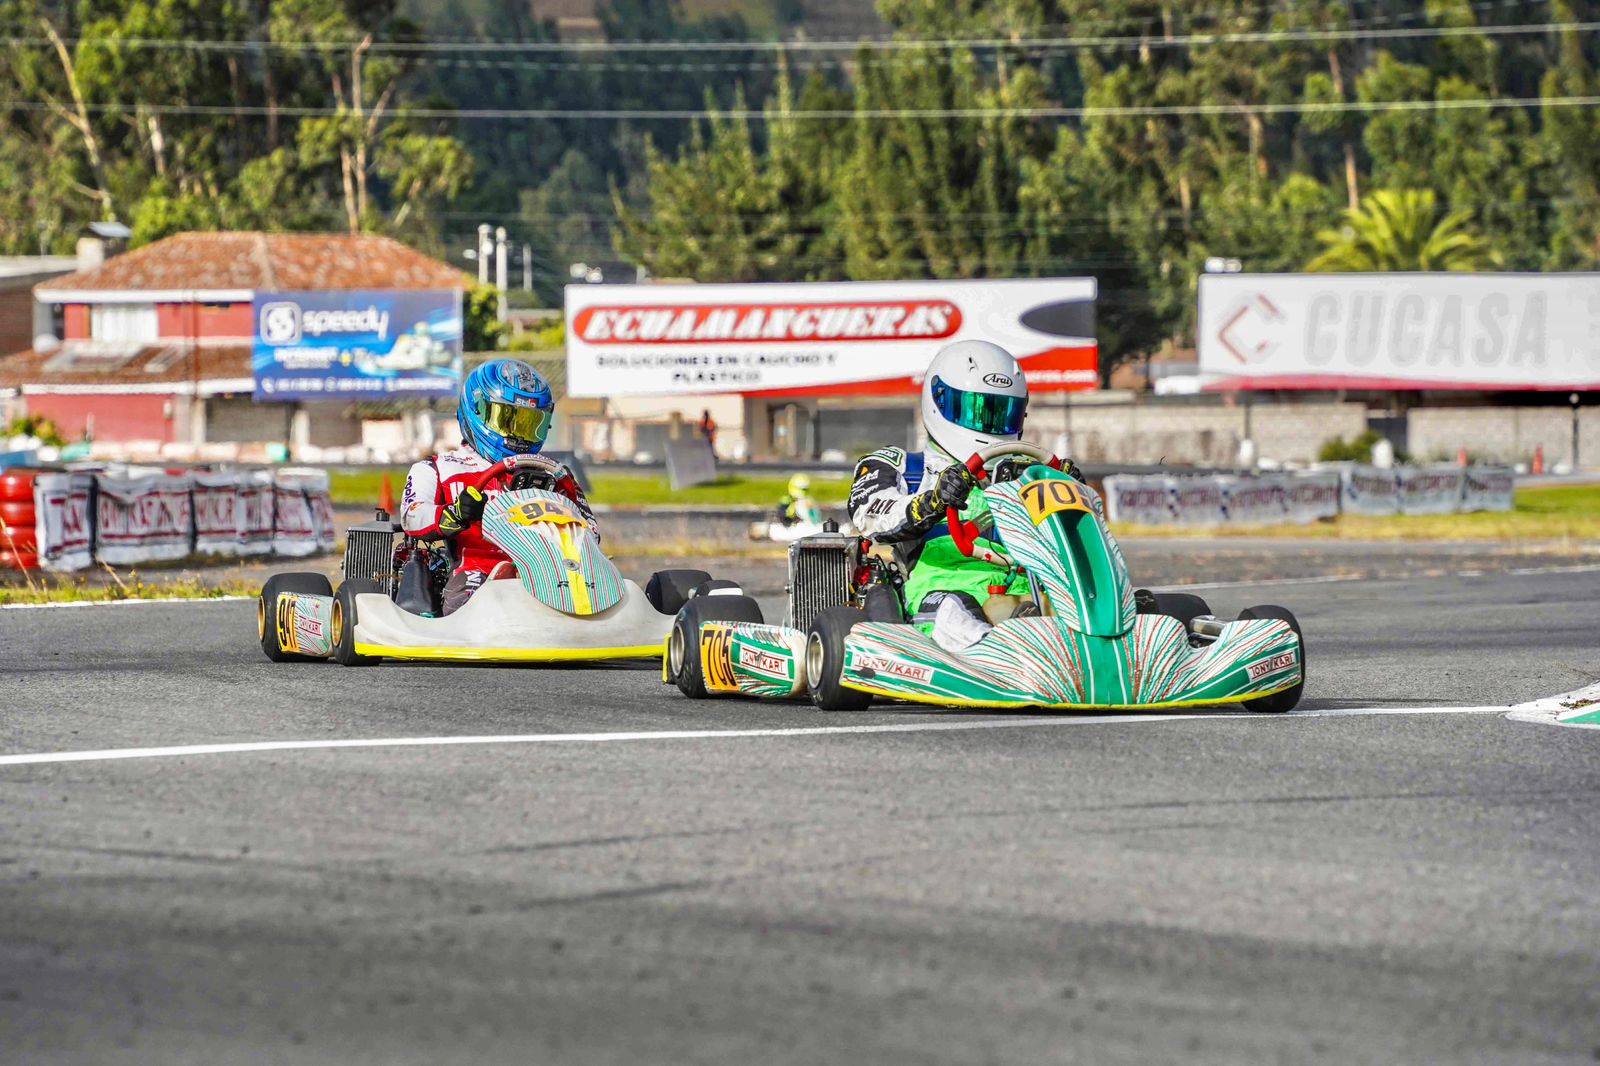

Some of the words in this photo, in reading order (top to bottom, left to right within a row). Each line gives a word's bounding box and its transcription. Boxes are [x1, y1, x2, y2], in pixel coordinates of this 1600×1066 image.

[302, 305, 389, 341] speedy
[1304, 290, 1548, 367] CUCASA
[985, 374, 1010, 385] Arai
[702, 629, 736, 686] 705
[894, 662, 929, 681] KART
